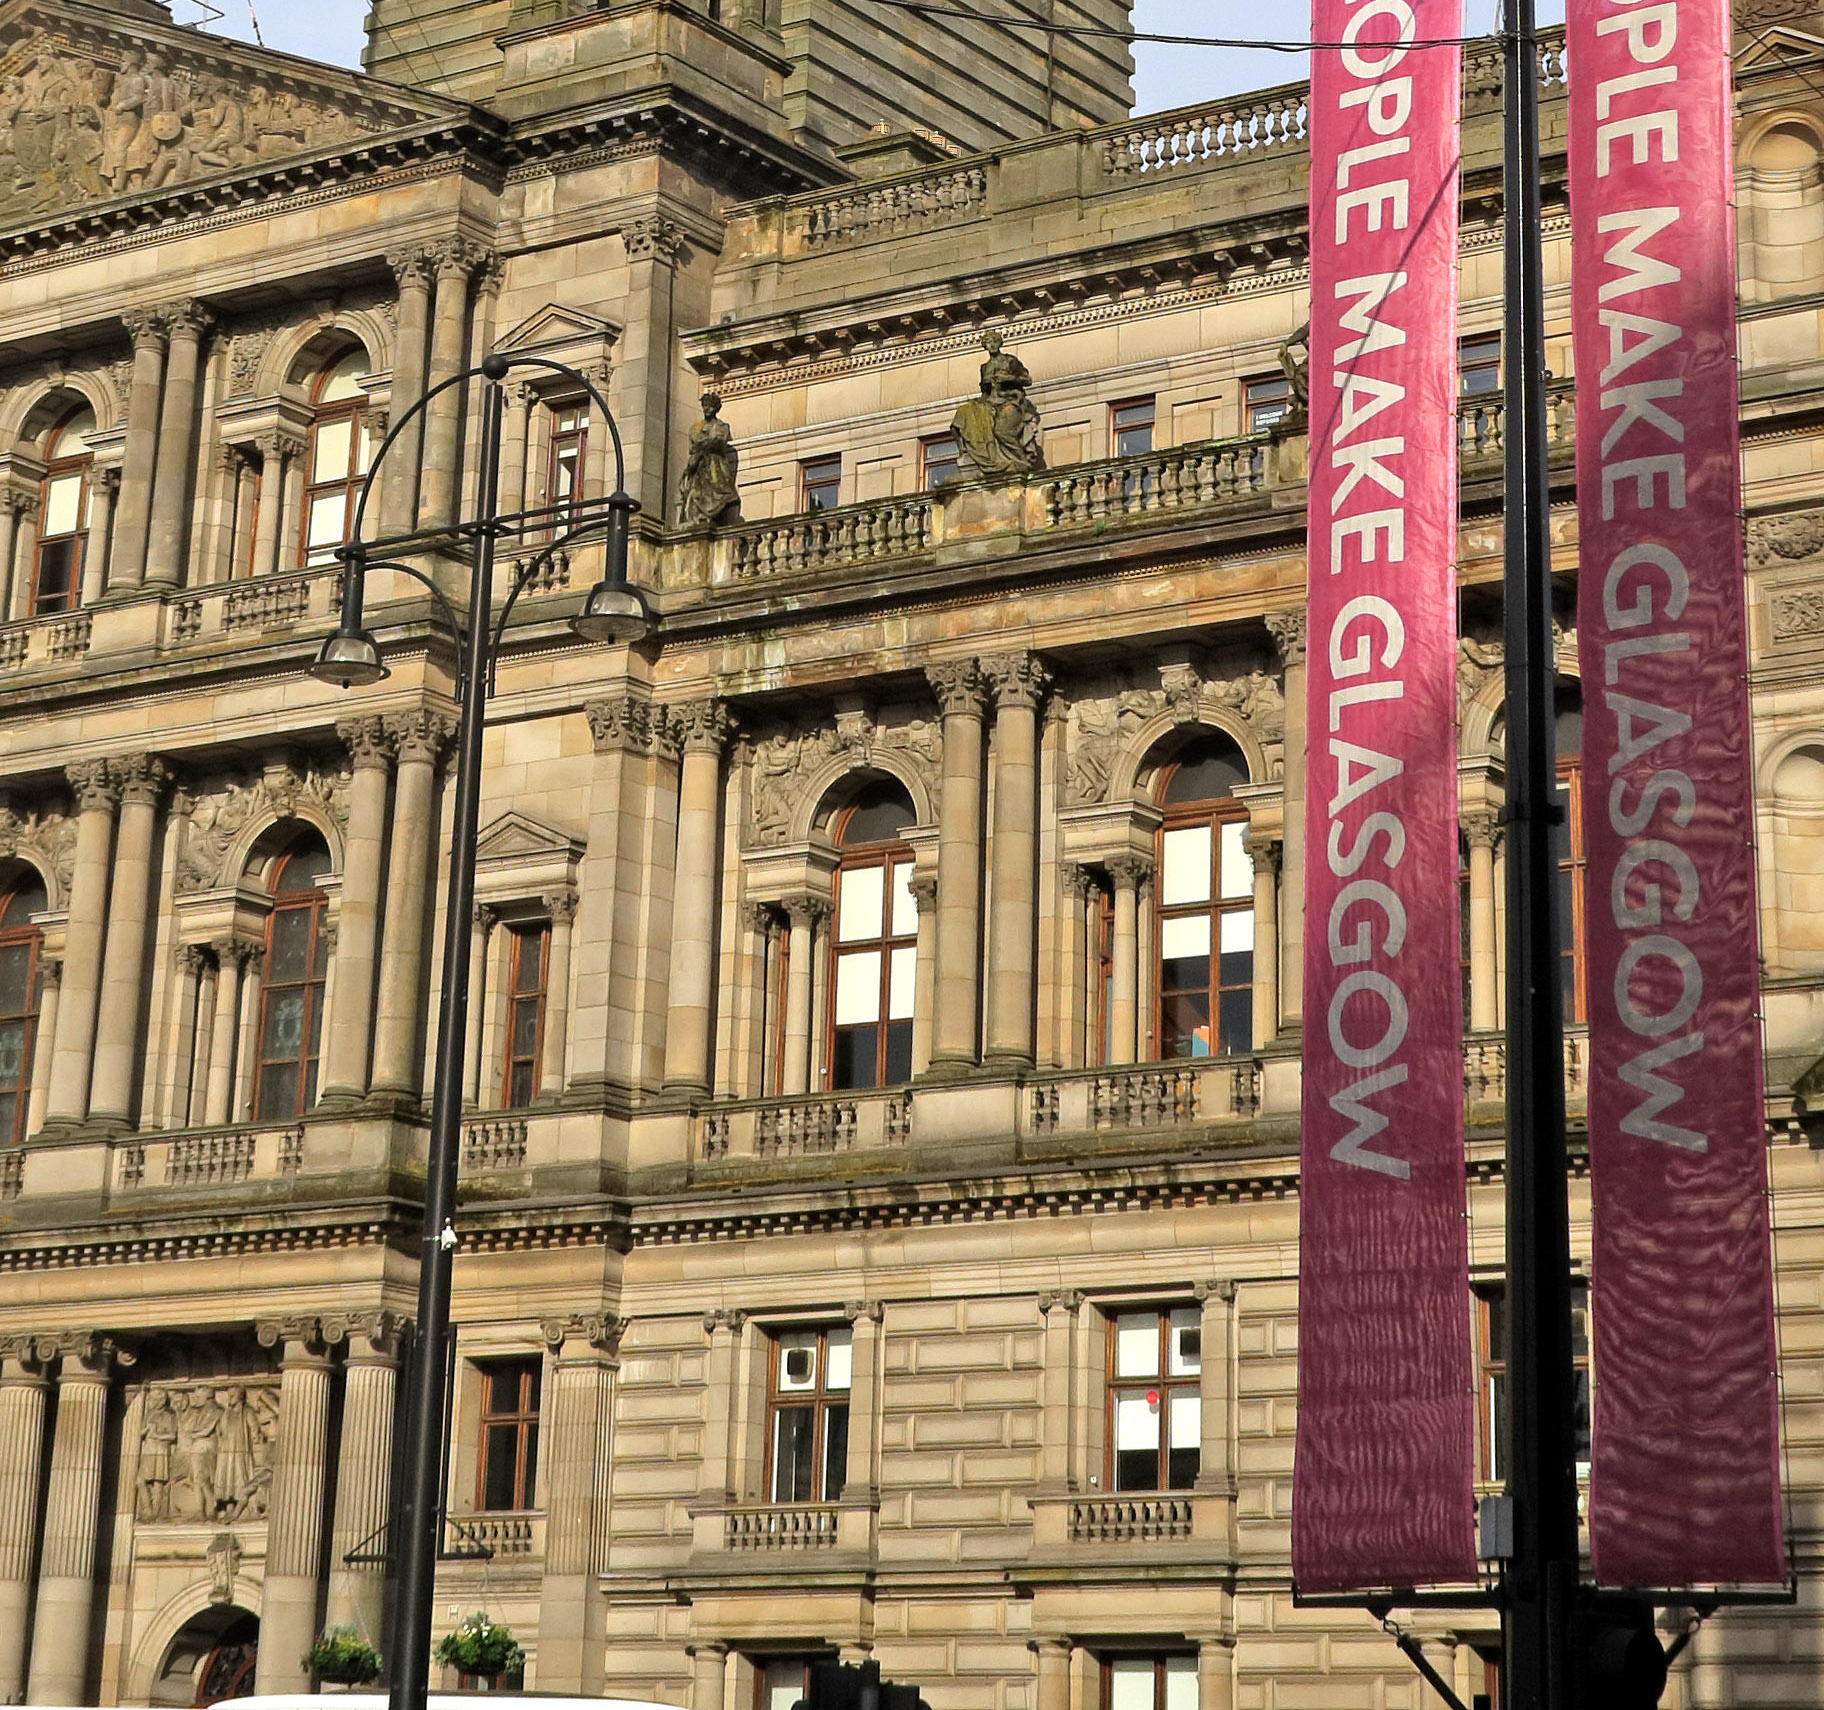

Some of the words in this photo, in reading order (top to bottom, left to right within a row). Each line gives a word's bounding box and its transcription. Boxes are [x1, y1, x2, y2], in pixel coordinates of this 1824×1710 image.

[1330, 270, 1408, 576] MAKE
[1597, 206, 1687, 522] MAKE
[1327, 594, 1411, 1182] GLASGOW
[1603, 542, 1709, 1155] GLASGOW
